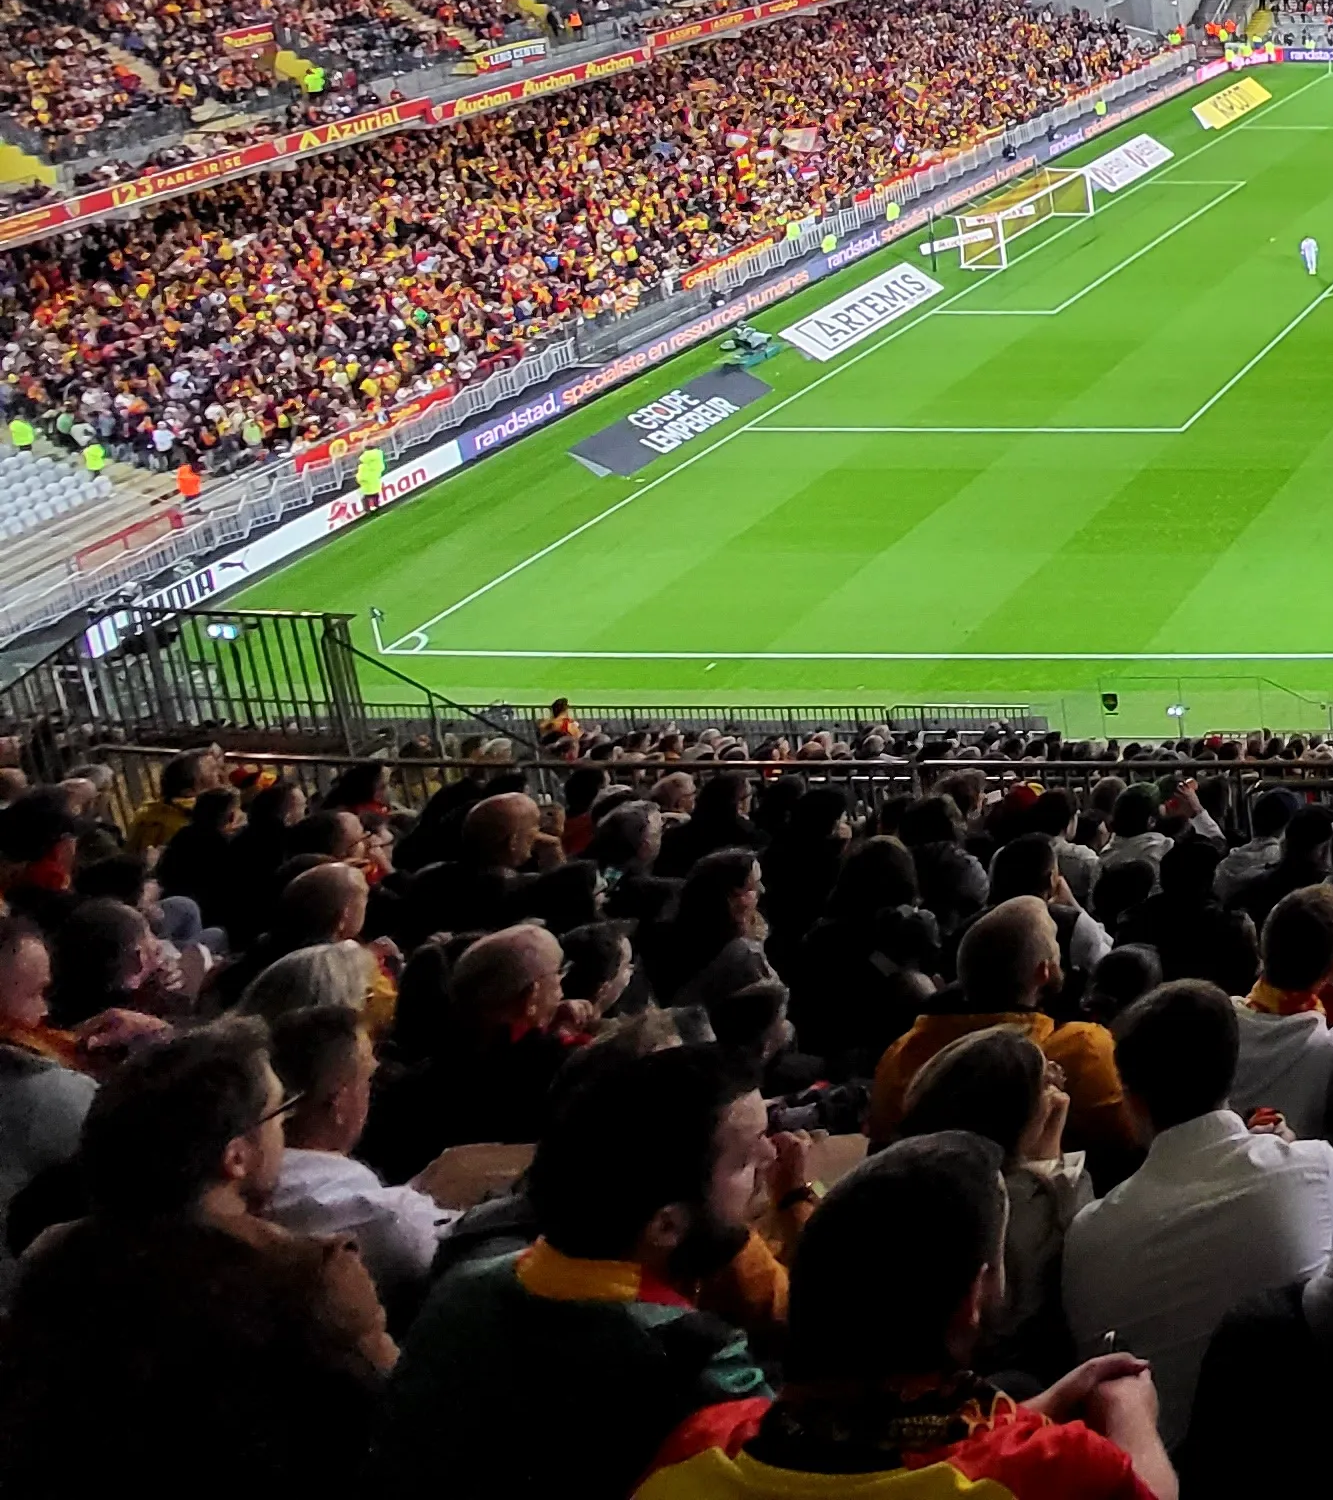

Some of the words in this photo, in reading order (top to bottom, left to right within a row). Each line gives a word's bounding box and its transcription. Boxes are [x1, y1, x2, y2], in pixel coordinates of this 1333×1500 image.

[454, 91, 511, 117] Auchan
[522, 72, 575, 96] Auchan
[585, 55, 634, 78] Auchan
[327, 108, 400, 143] Azurial
[112, 177, 154, 206] 123
[827, 231, 881, 270] randstad,
[814, 273, 926, 342] ARTEMIS
[473, 391, 562, 450] randstad,
[562, 351, 646, 406] spécialiste
[648, 340, 669, 360] en
[669, 300, 746, 349] ressources
[748, 269, 809, 313] humaines
[627, 388, 700, 431] GROUPE
[639, 396, 741, 454] LEMPEREUR
[328, 467, 427, 530] Auhan
